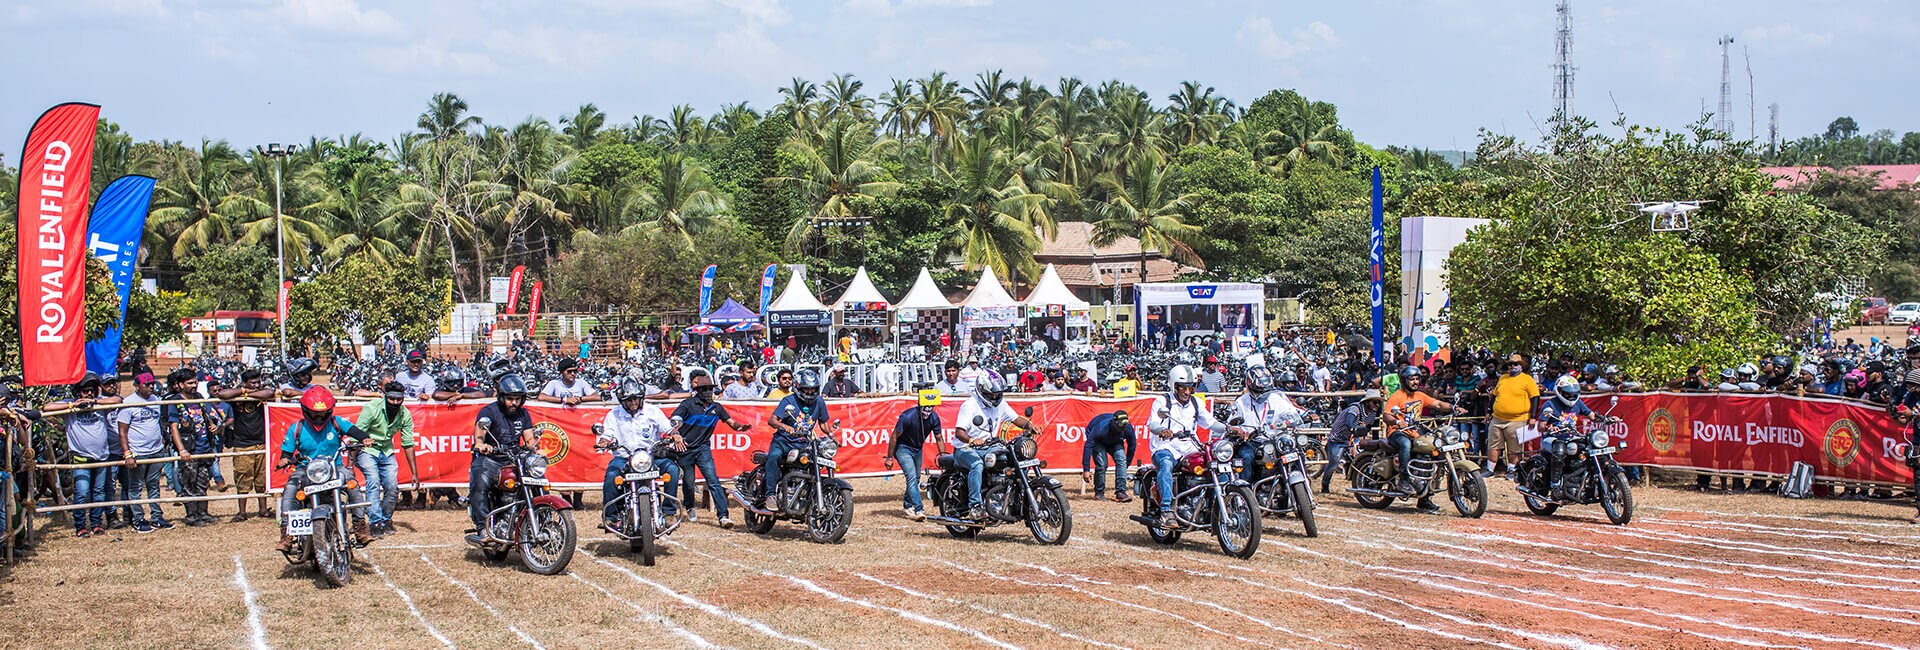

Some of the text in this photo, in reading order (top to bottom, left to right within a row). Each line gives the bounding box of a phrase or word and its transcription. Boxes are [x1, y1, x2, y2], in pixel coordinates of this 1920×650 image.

[36, 140, 72, 343] ROYAL ENFIELD
[1192, 288, 1213, 296] CEAT
[1693, 420, 1742, 443] ROYAL
[1746, 422, 1805, 448] ENFIELD
[291, 519, 311, 528] 036
